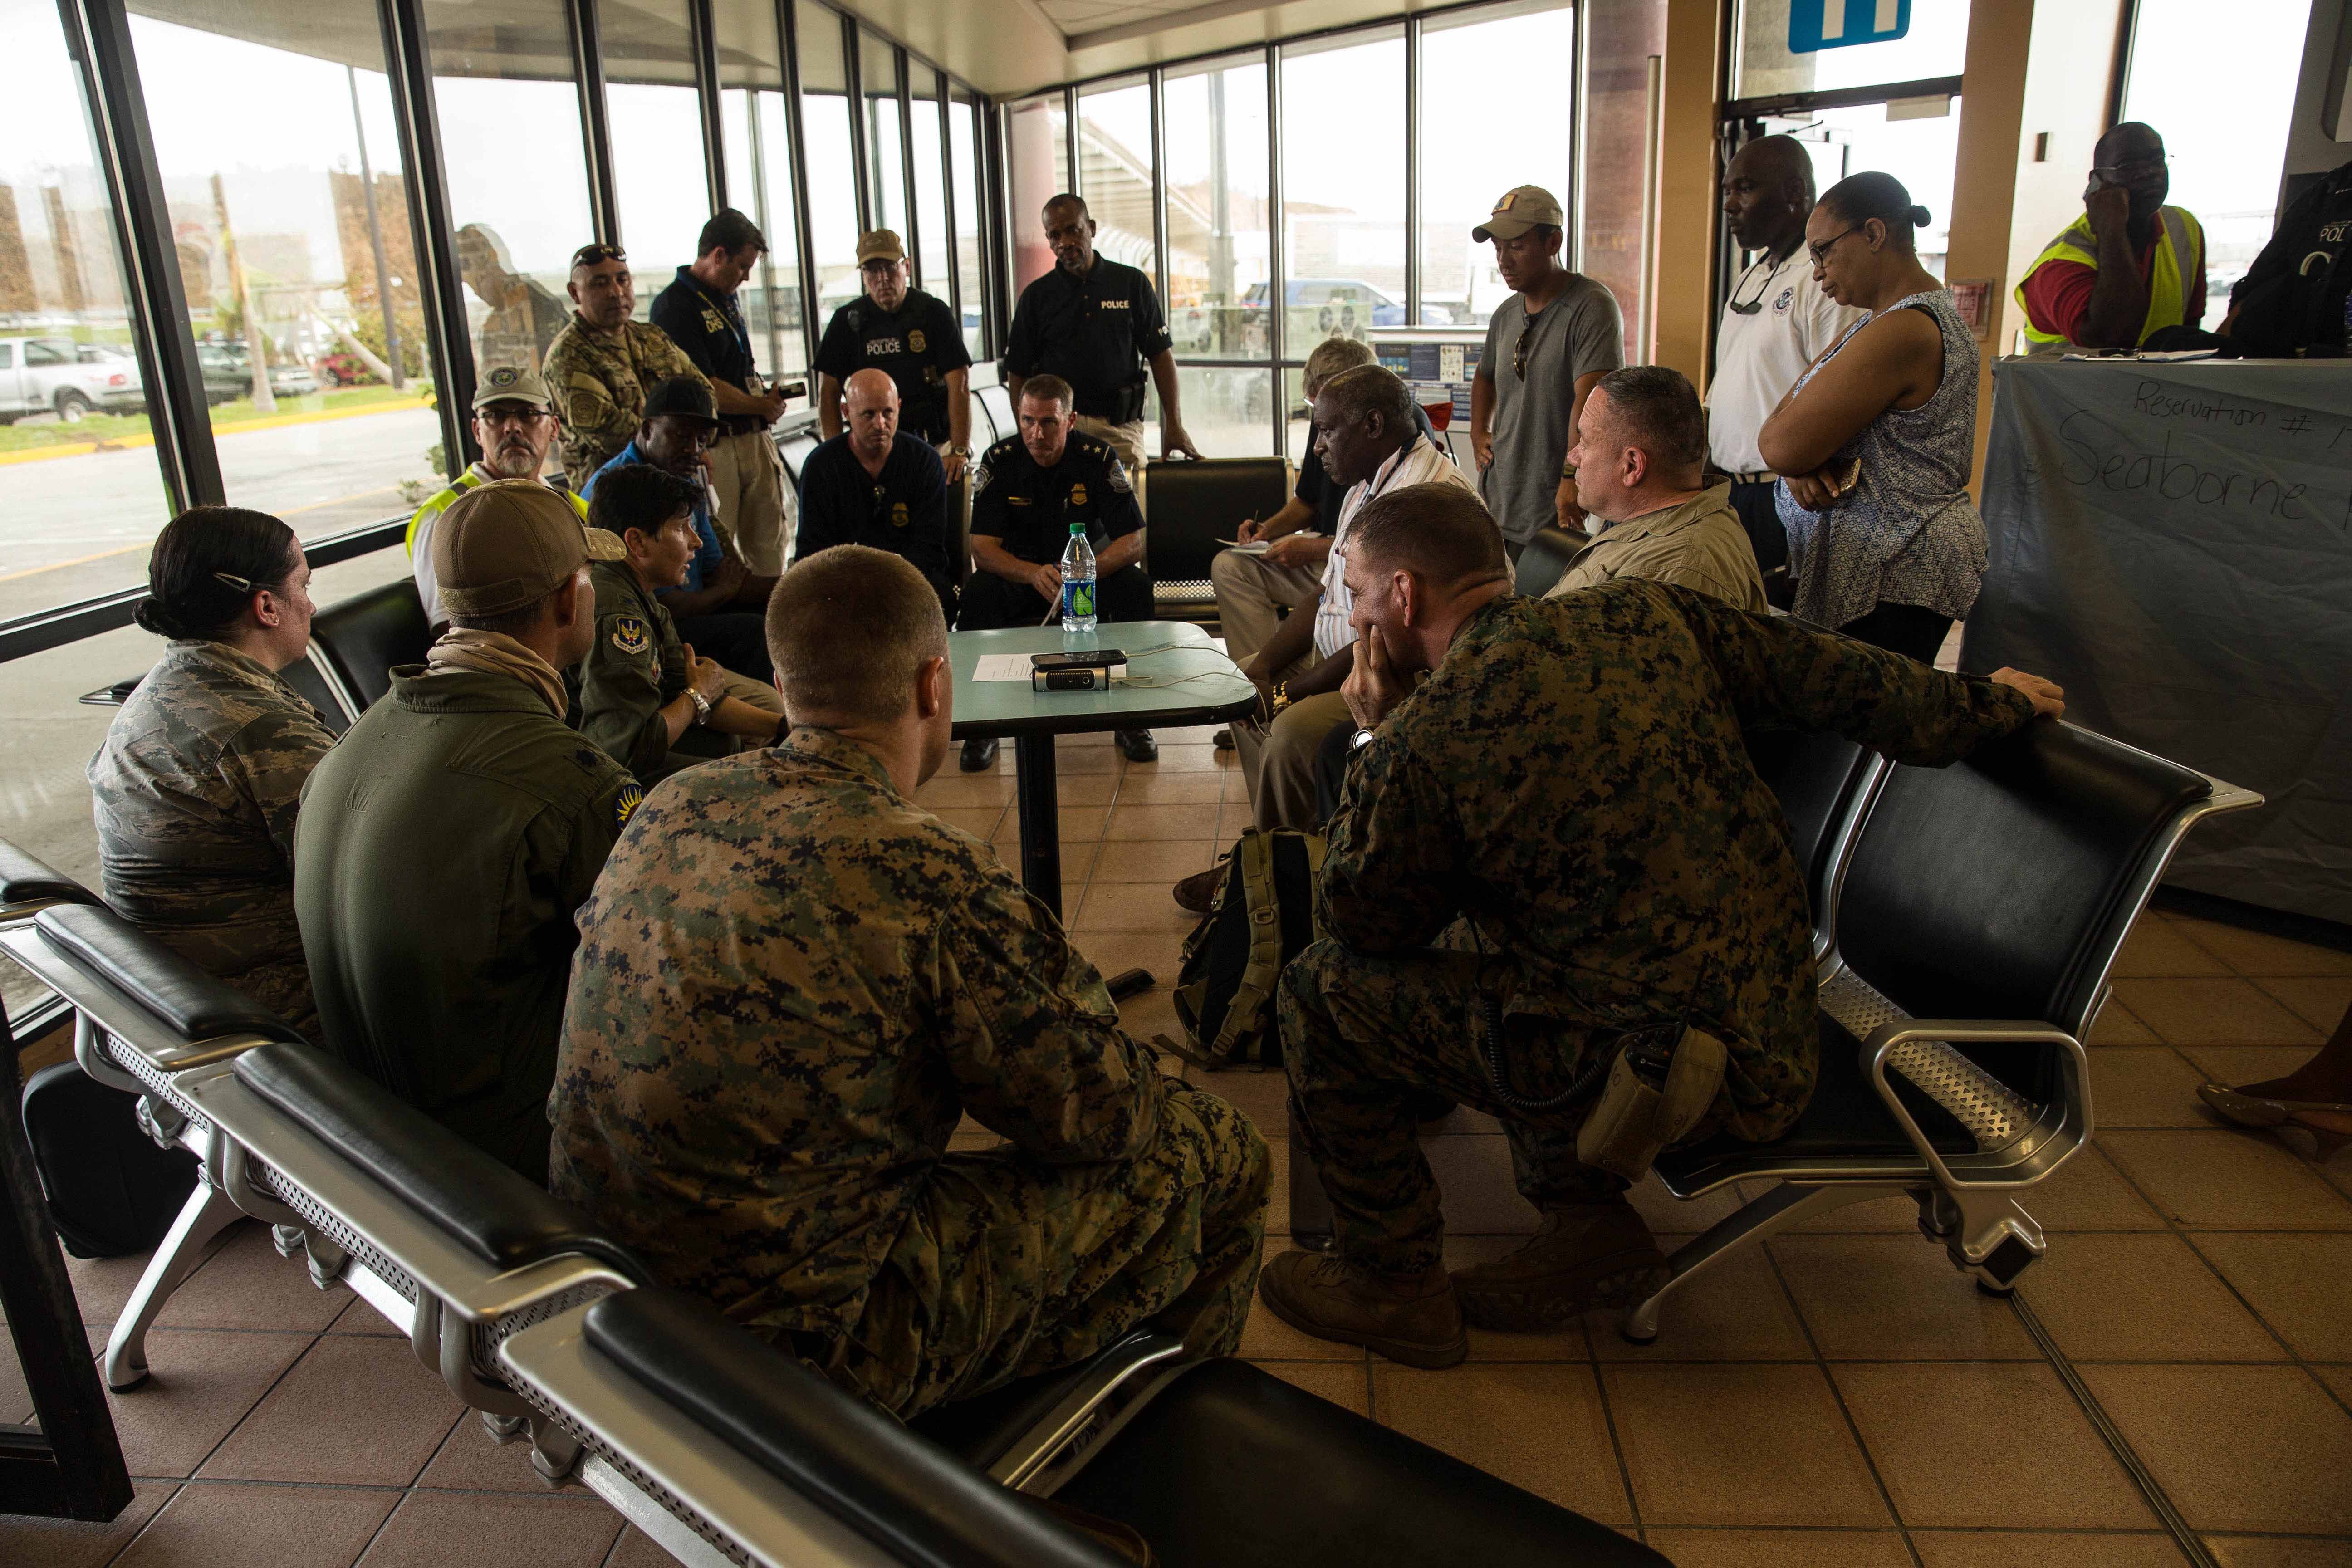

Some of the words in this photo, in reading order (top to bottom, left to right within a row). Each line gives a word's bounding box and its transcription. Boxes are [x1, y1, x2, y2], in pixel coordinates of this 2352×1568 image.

[1101, 300, 1130, 309] POLICE
[866, 341, 901, 355] POLICE
[2134, 381, 2266, 426] Reservation
[2279, 415, 2313, 436] #
[2059, 409, 2307, 520] Seaborne
